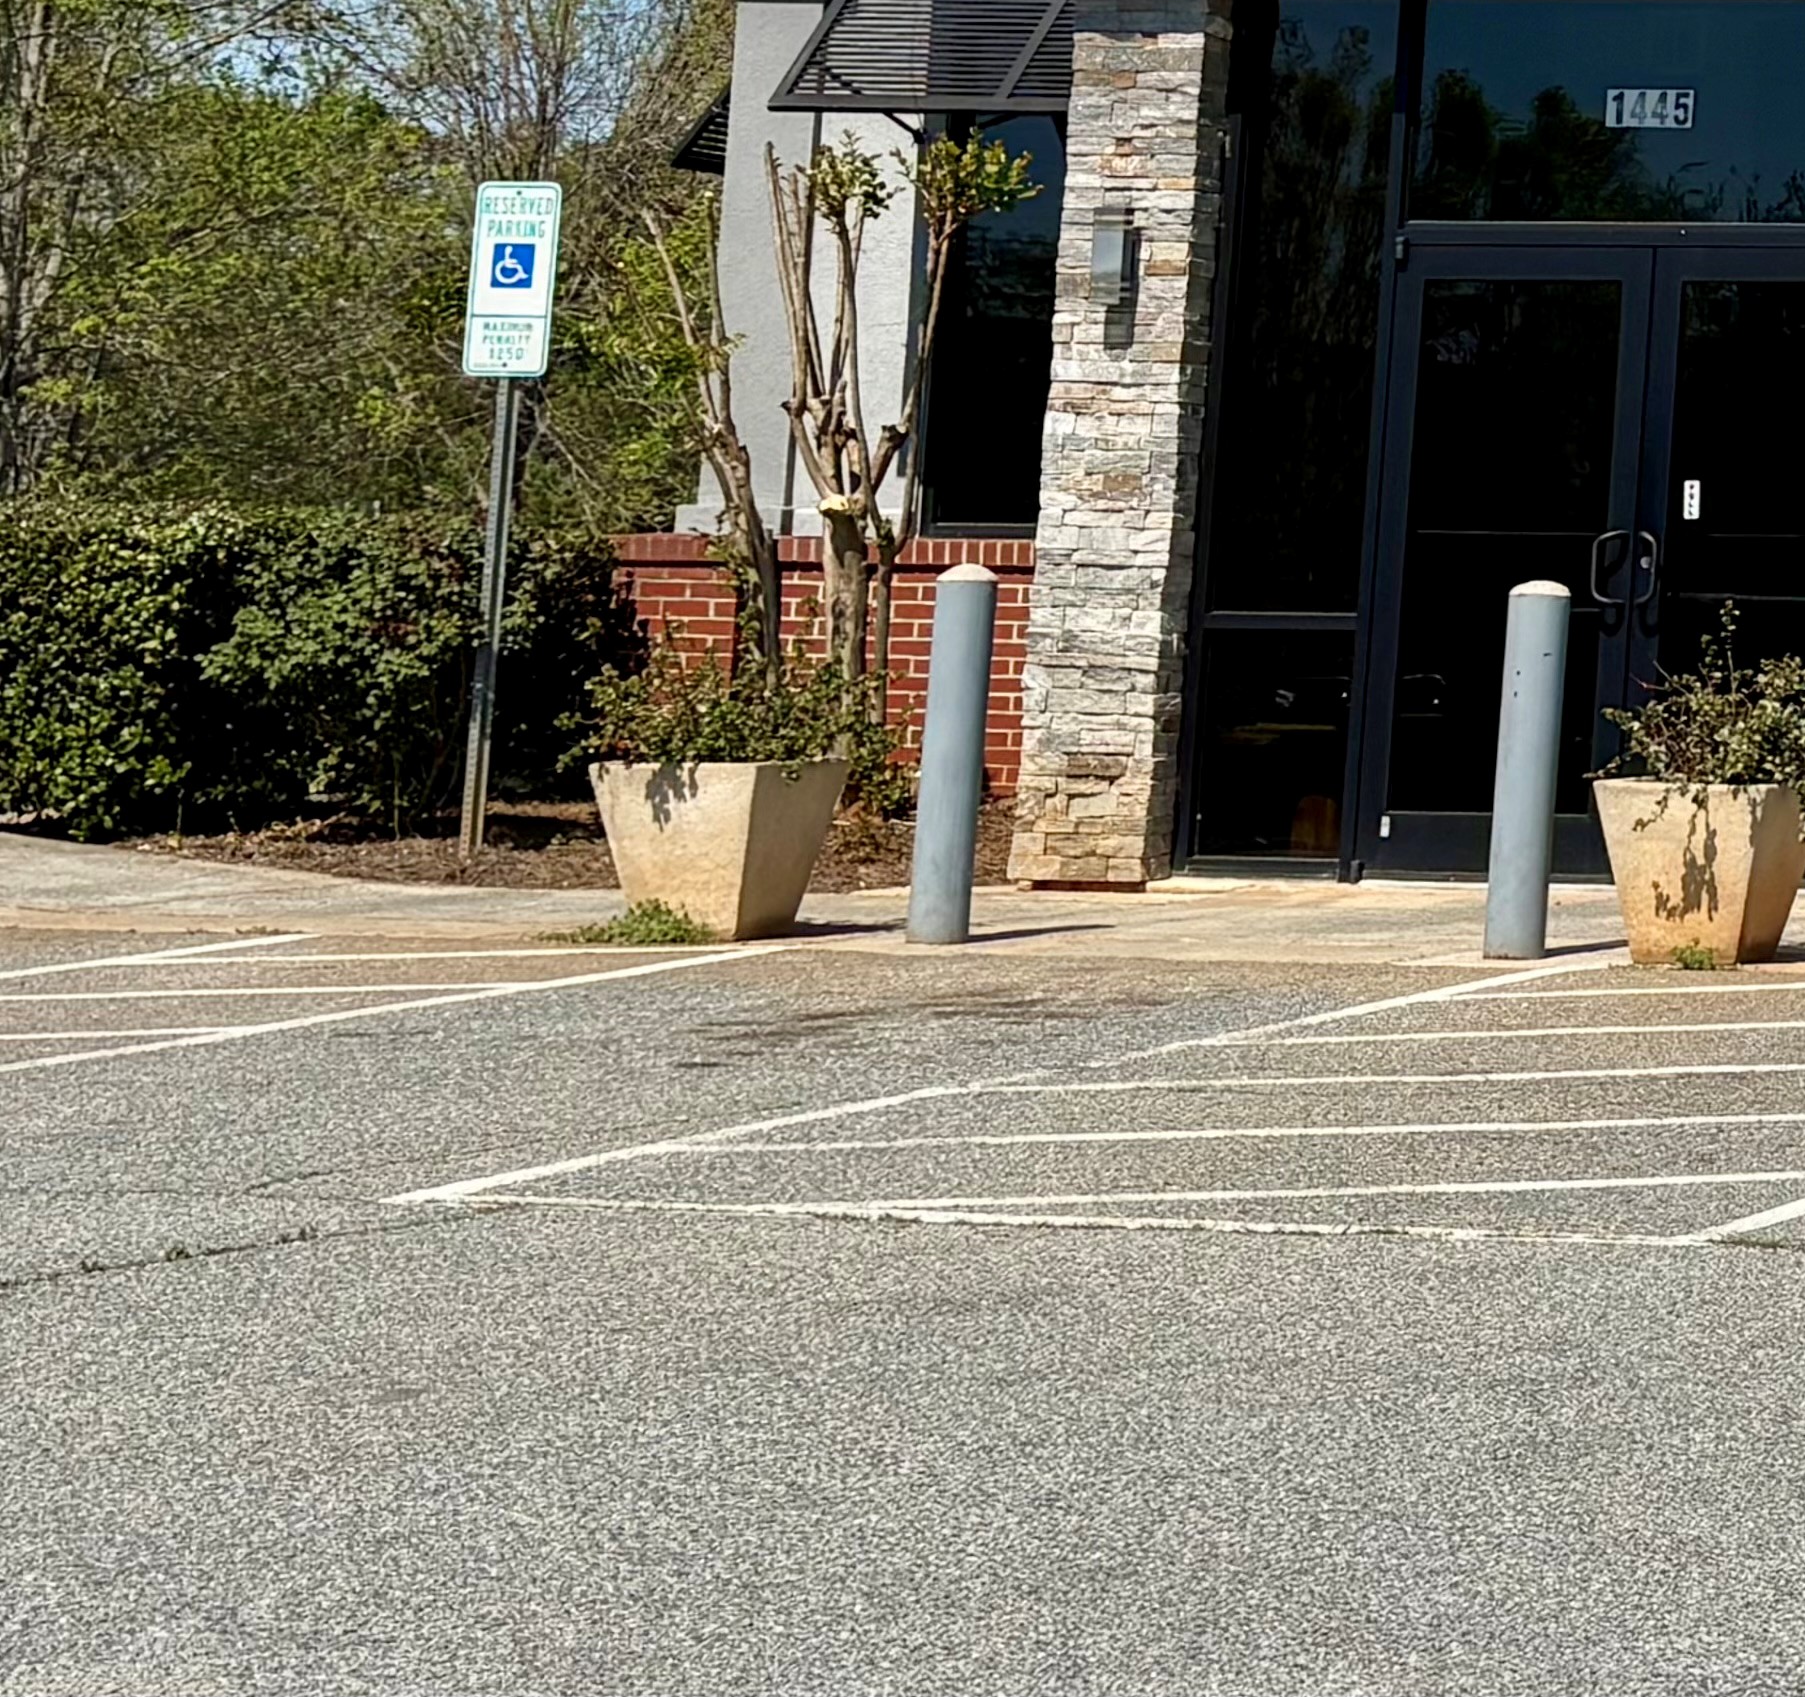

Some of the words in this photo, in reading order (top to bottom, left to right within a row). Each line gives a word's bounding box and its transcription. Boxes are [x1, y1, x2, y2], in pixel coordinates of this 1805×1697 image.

[1612, 90, 1690, 126] 1445
[481, 196, 554, 215] RESERVED
[487, 219, 546, 239] PARKING
[482, 334, 531, 346] PENALTY
